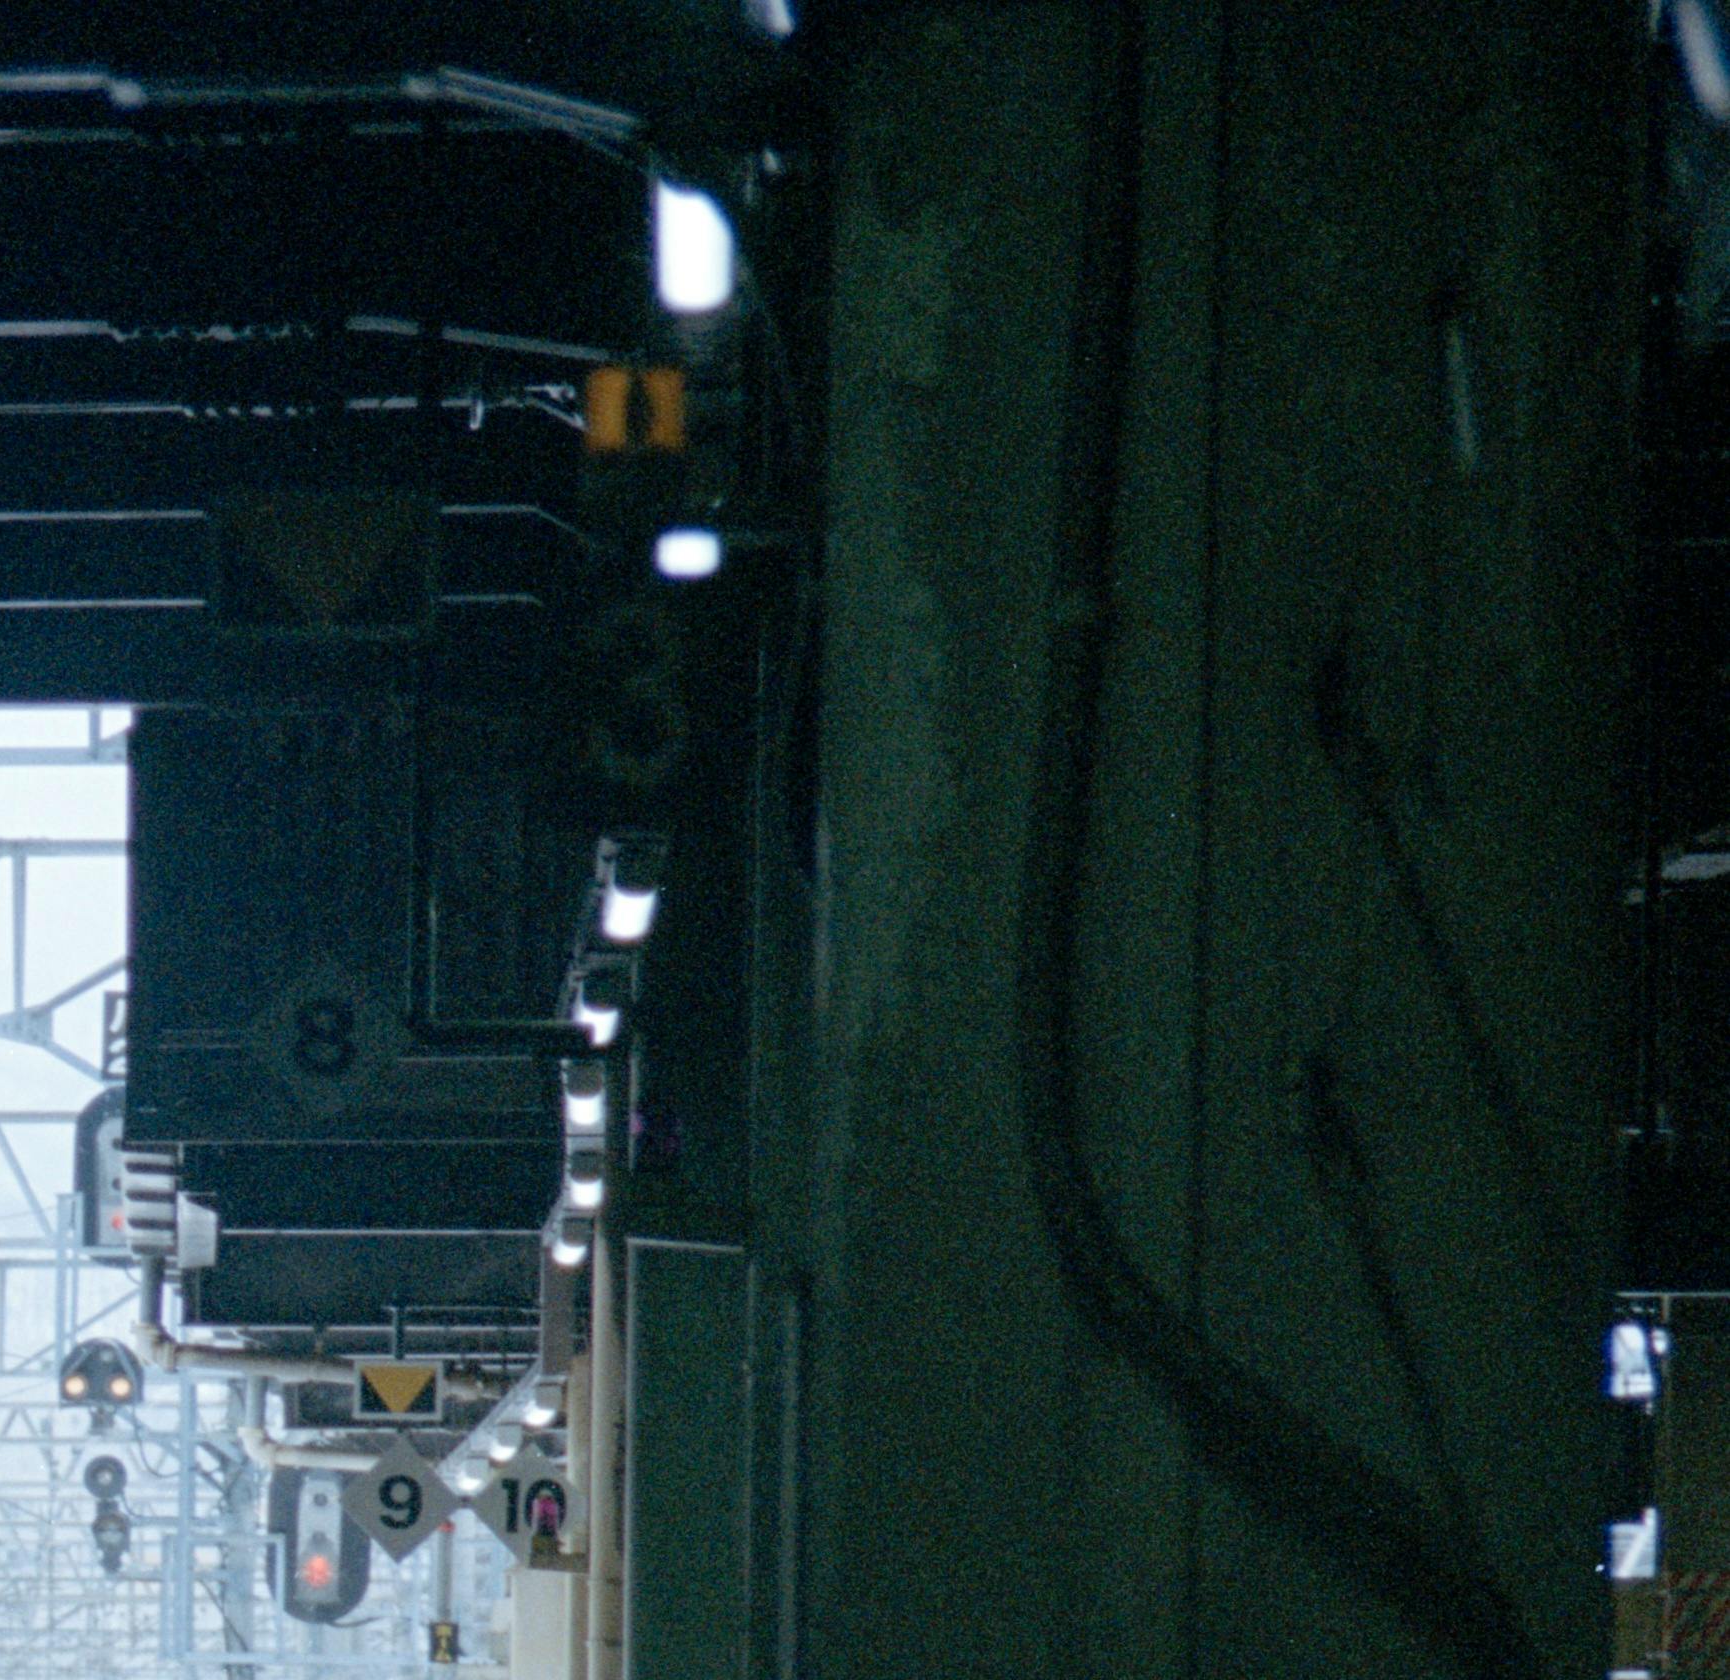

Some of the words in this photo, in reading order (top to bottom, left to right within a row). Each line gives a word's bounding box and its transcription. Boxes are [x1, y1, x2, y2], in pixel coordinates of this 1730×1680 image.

[295, 998, 357, 1075] 8
[378, 1475, 423, 1530] 9
[501, 1478, 566, 1533] 10
